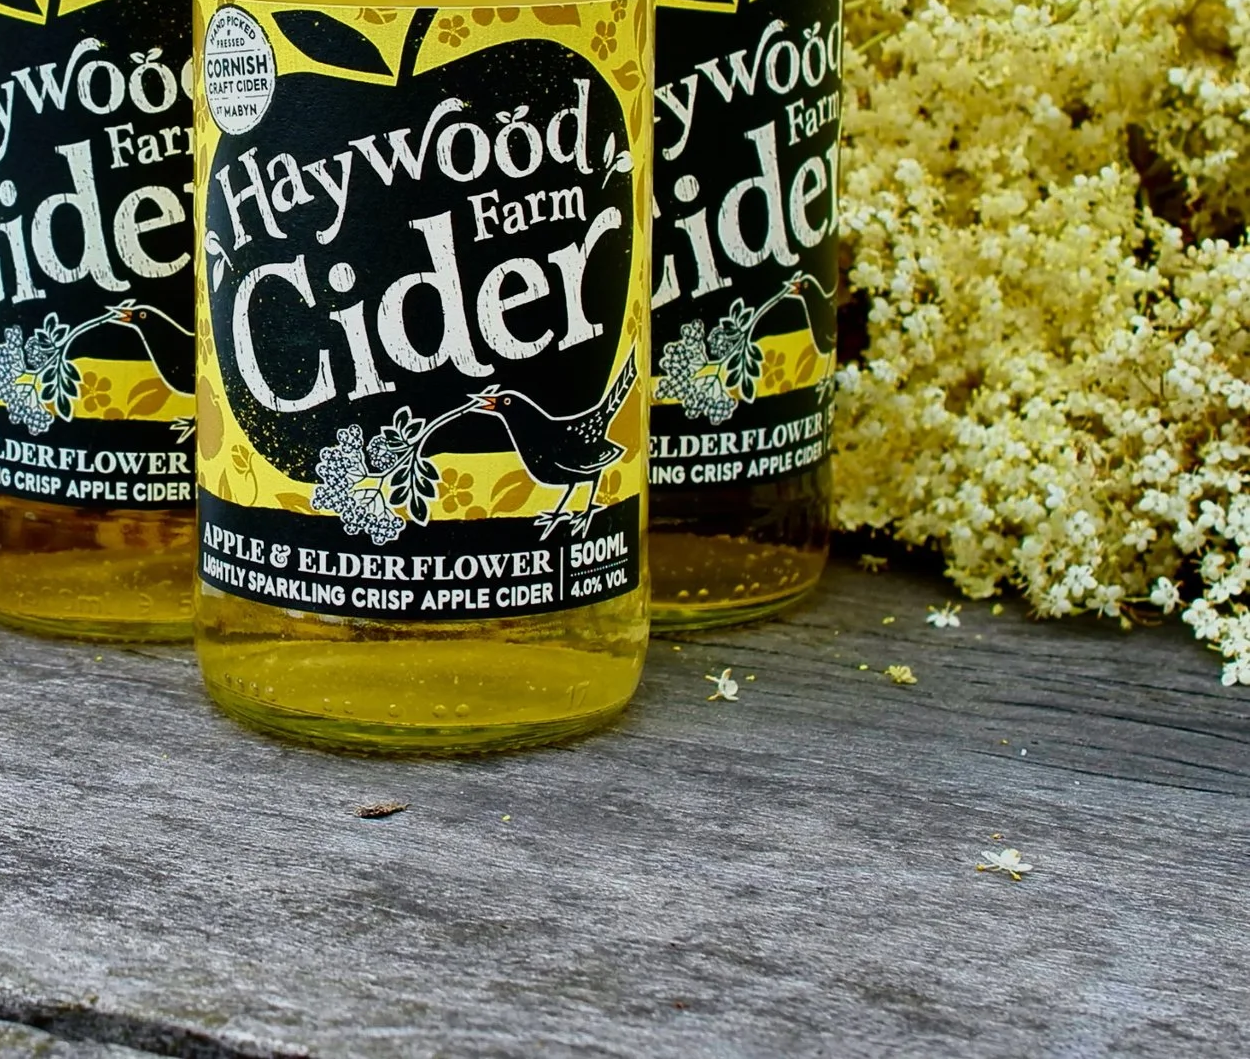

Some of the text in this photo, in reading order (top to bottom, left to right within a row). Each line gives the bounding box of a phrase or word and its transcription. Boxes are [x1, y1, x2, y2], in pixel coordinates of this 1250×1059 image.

[210, 16, 256, 45] HAND PICKED
[217, 37, 245, 48] PRESSED
[207, 54, 268, 79] CORNISH
[209, 78, 269, 95] CRAFT CIDER
[224, 103, 258, 118] MABYN
[467, 185, 587, 243] Farm
[231, 206, 622, 413] Cider
[690, 460, 743, 483] CRISP
[747, 450, 793, 479] APPLE
[794, 440, 822, 466] CIDER
[14, 471, 62, 495] CRISP
[66, 480, 129, 501] APPLE
[133, 482, 191, 502] CIDER
[203, 521, 553, 581] APPLE & ELDERFLOWER
[570, 531, 628, 568] 500ML
[203, 551, 554, 611] LIGHTLY SPARKLING CRISP APPLE CIDER
[571, 568, 628, 597] 4.0% VOL
